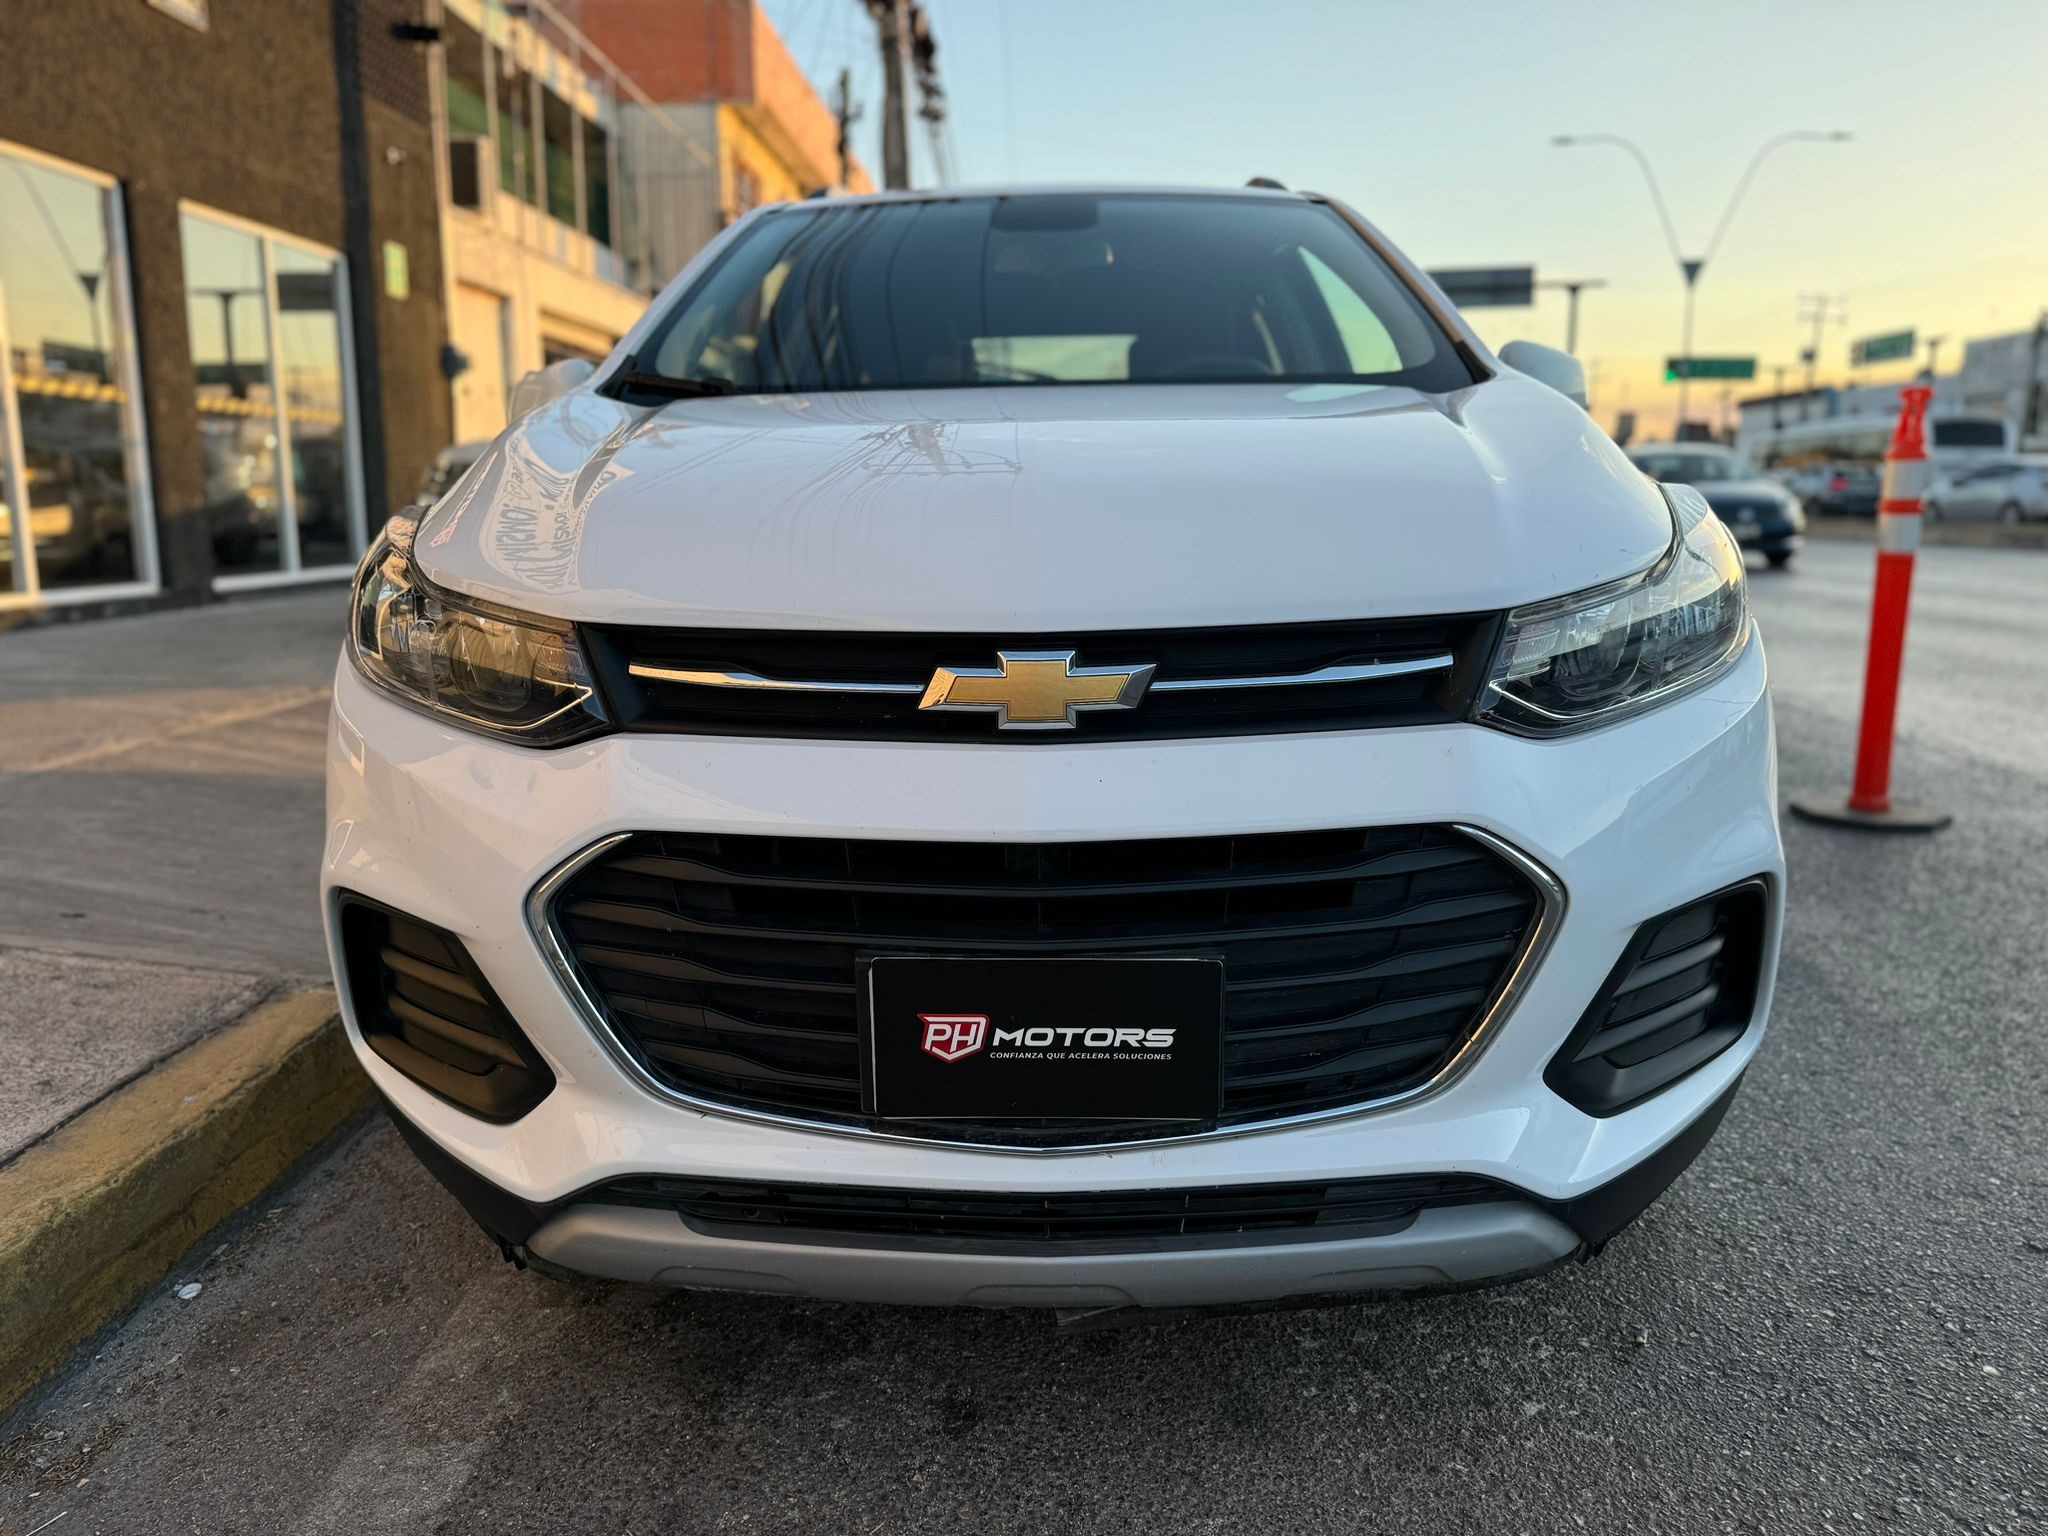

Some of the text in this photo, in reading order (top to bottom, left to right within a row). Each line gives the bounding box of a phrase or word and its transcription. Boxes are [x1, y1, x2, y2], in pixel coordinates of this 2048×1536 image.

[924, 1023, 1177, 1053] PH MOTORS
[989, 1051, 1044, 1059] CONFIANZA
[1046, 1052, 1067, 1060] QUE
[1068, 1052, 1111, 1060] ACELERA
